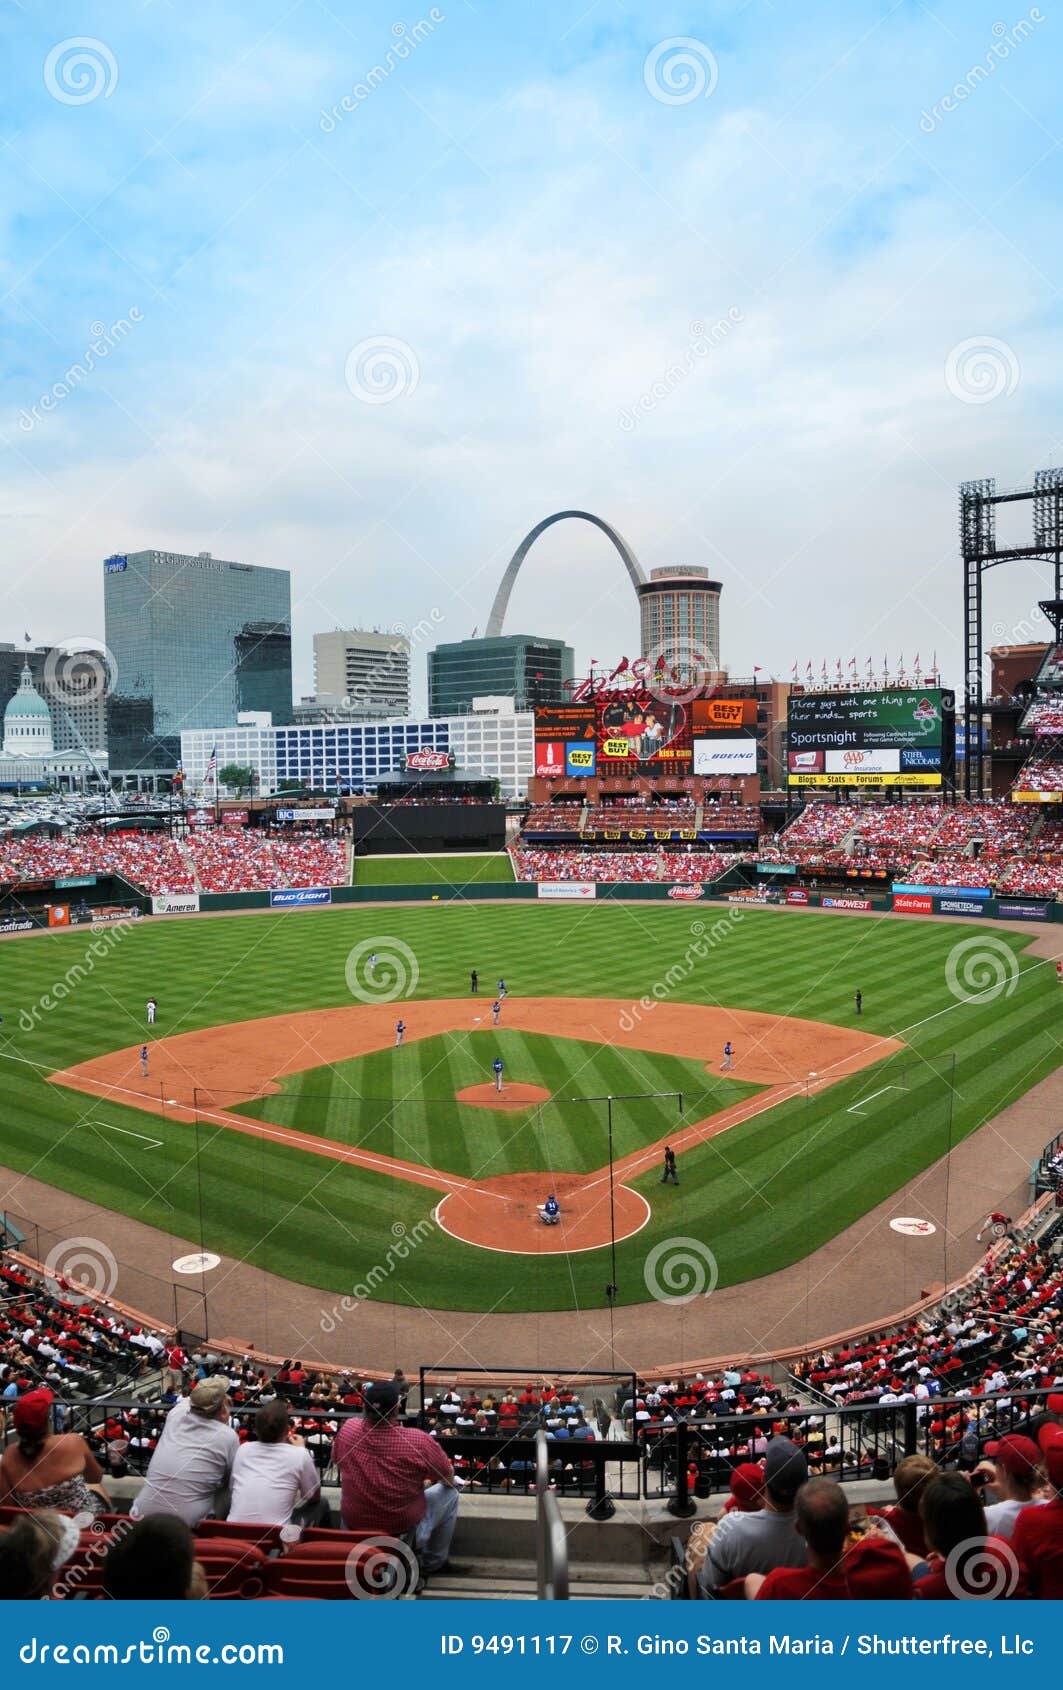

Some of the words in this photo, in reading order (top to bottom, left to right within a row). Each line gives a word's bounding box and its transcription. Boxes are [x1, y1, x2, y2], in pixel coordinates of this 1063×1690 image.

[104, 563, 125, 575] KPMG
[803, 683, 848, 692] WORLD
[850, 679, 925, 690] CHAMPIONS
[790, 700, 815, 709] Three
[820, 700, 837, 710] guys
[840, 697, 858, 706] with
[881, 695, 903, 706] thing
[713, 704, 743, 712] BEST
[714, 712, 739, 720] BUY
[790, 712, 811, 720] their
[849, 709, 878, 719] sports
[790, 731, 857, 746] Sportsnight
[658, 749, 674, 757] kiss
[711, 752, 754, 760] BOEING
[902, 751, 923, 759] STIFEL
[845, 752, 863, 763] AAA
[905, 757, 941, 765] NICOLAUS
[798, 776, 817, 785] Blogs
[297, 892, 328, 900] LIGHT
[165, 904, 196, 912] Ameren
[832, 900, 870, 909] MIDWEST
